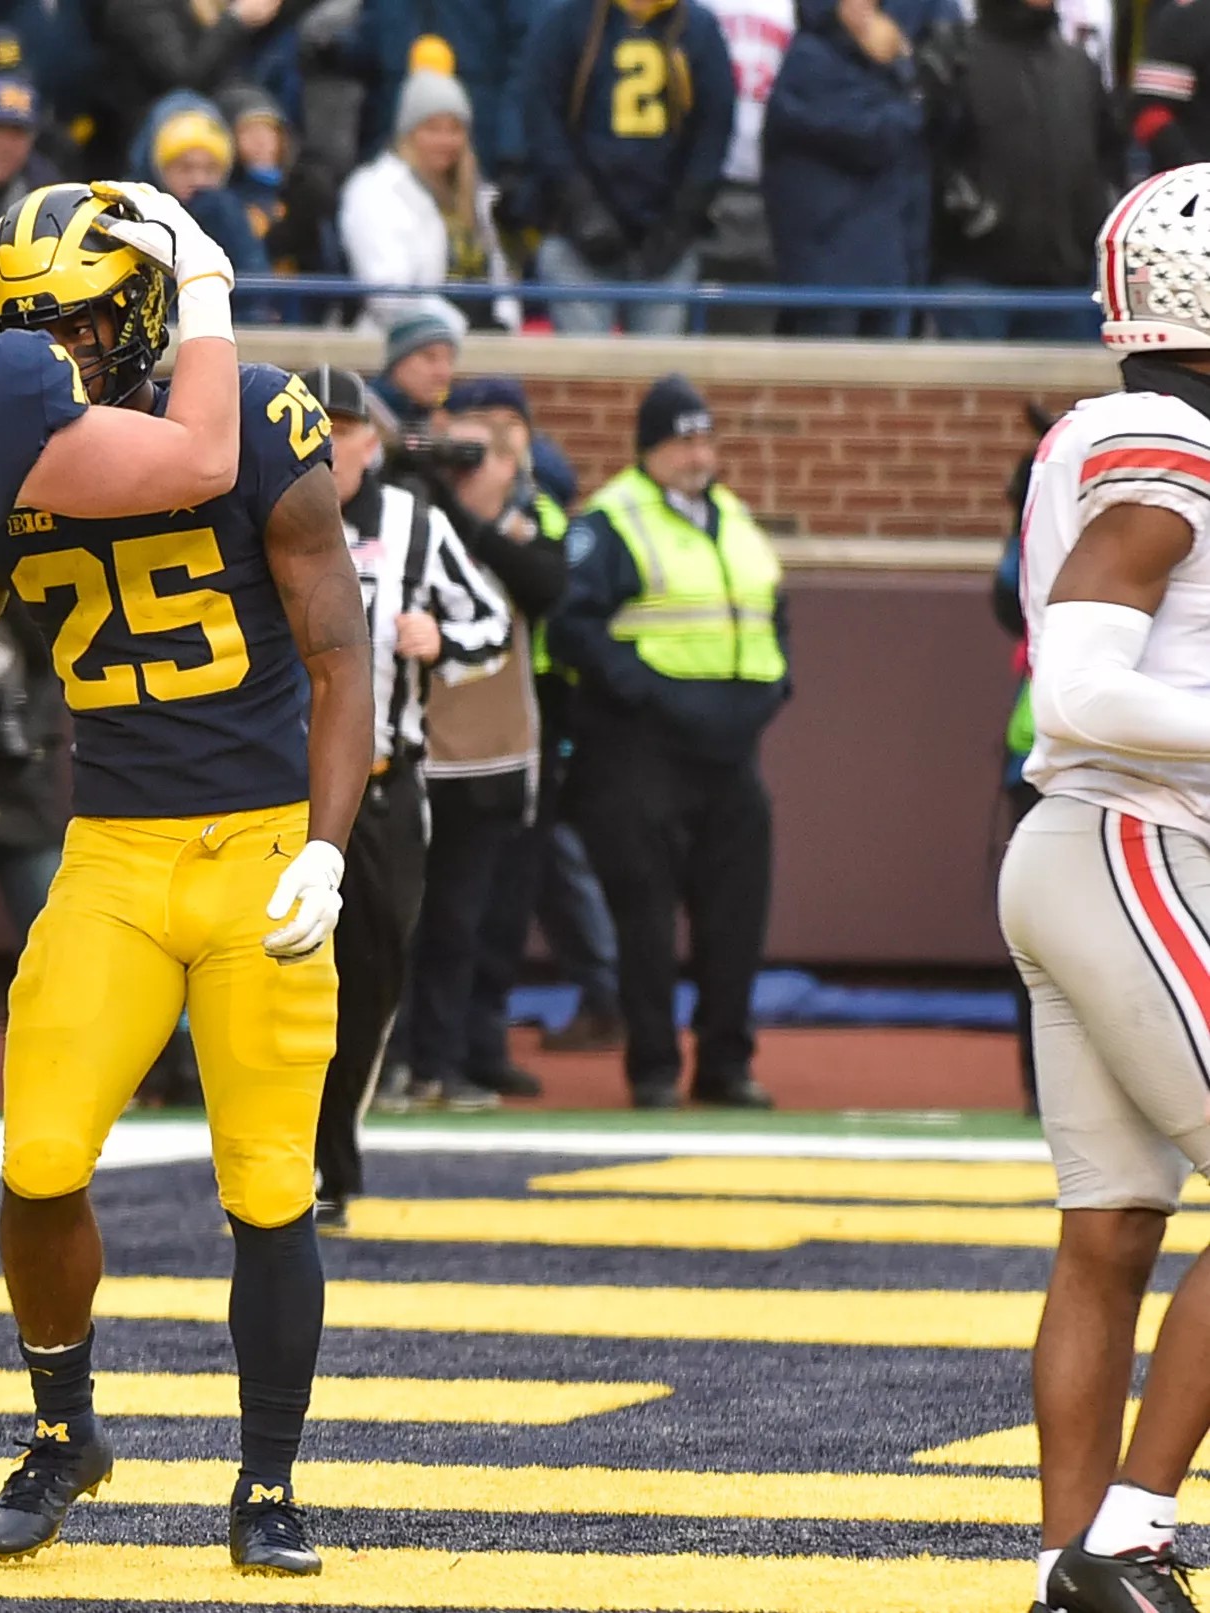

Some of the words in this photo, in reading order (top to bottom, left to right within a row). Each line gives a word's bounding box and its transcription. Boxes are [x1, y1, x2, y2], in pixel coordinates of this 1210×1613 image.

[16, 296, 36, 312] M
[7, 512, 54, 536] BIG
[10, 527, 251, 712] 25
[35, 1419, 71, 1442] M
[247, 1483, 284, 1504] M
